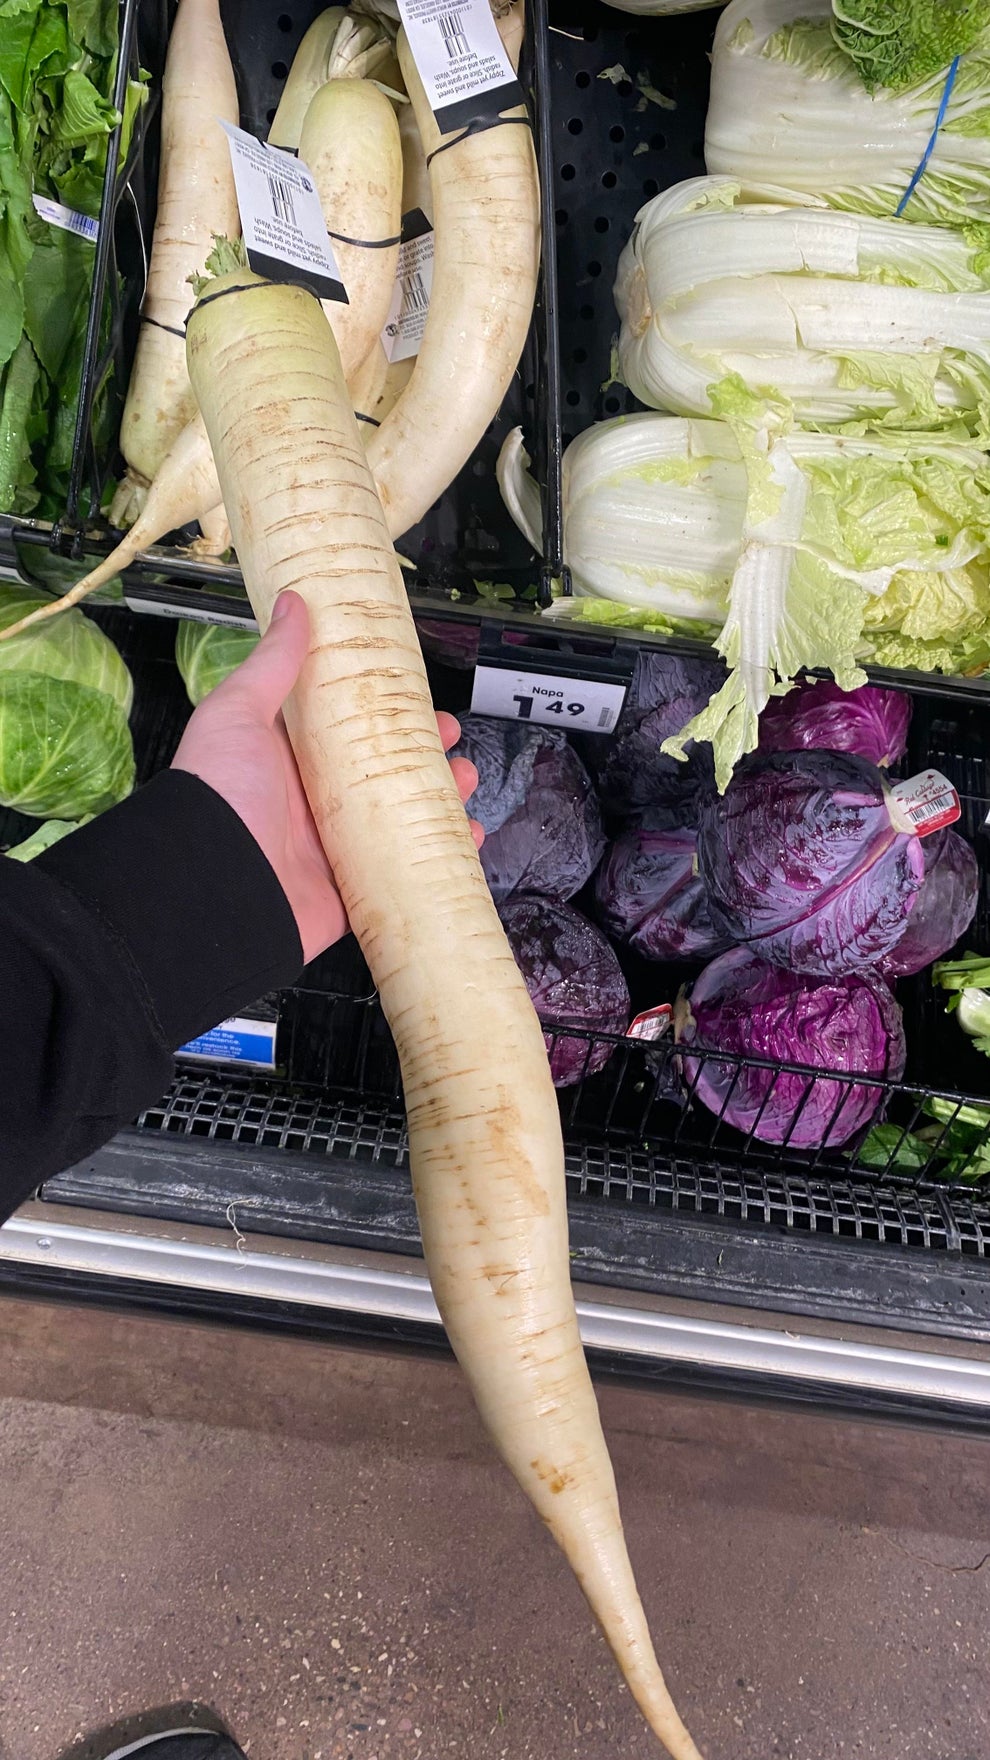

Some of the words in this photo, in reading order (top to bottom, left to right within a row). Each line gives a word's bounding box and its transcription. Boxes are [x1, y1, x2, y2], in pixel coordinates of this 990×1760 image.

[447, 59, 459, 67] use.
[460, 53, 478, 63] before
[479, 56, 496, 66] salads
[468, 61, 478, 70] and
[434, 72, 450, 81] Wash
[470, 69, 483, 78] Slice
[489, 71, 506, 80] Zippy
[448, 75, 462, 85] grate
[479, 74, 489, 84] yet
[435, 82, 447, 90] into
[455, 84, 466, 93] and
[466, 80, 479, 89] mild
[438, 88, 454, 99] sweet
[254, 217, 273, 231] Wash
[254, 226, 267, 238] into
[284, 222, 304, 237] before
[255, 235, 273, 247] sweet
[268, 232, 284, 243] grate
[292, 234, 304, 244] and
[275, 243, 286, 252] and
[292, 243, 307, 254] Slice
[407, 242, 417, 251] and
[288, 248, 302, 258] mild
[302, 254, 312, 262] yet
[410, 249, 423, 259] grate
[208, 617, 247, 628] Radish
[532, 687, 564, 698] Napa
[513, 695, 534, 719] 1
[545, 701, 585, 716] 49
